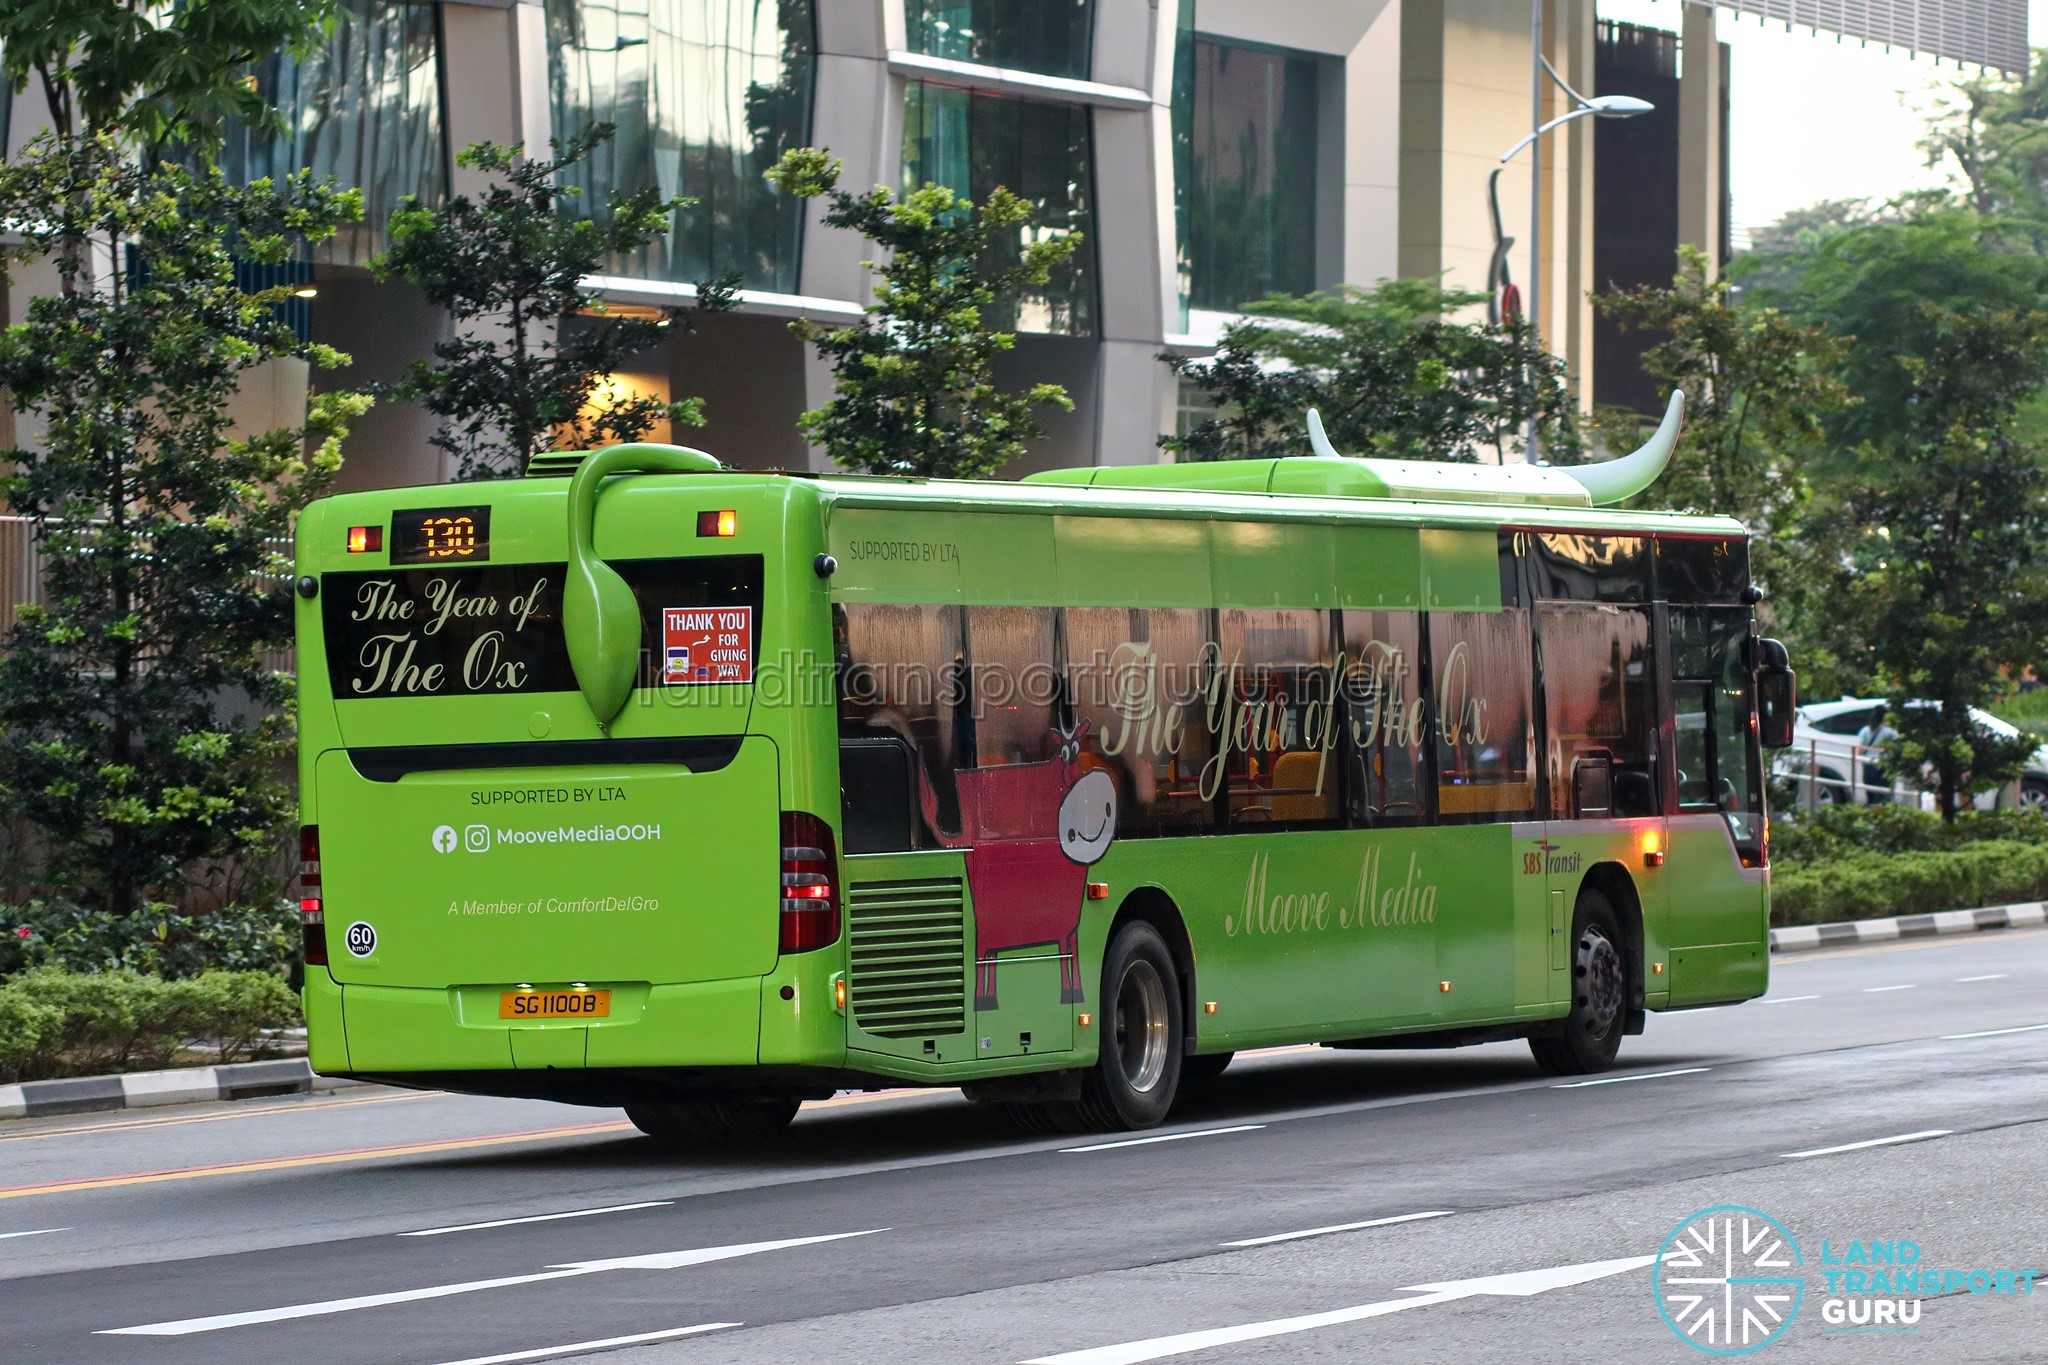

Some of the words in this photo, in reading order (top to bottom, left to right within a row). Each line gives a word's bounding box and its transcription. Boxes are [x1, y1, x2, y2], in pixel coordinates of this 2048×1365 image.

[421, 517, 474, 556] 130
[850, 541, 920, 561] SUPPORTED
[922, 543, 937, 561] BY
[940, 544, 960, 562] LTA
[351, 579, 416, 621] The
[423, 578, 499, 635] Year
[509, 577, 548, 632] of
[668, 613, 714, 631] THANK
[717, 612, 745, 630] YOU
[718, 633, 739, 646] FOR
[352, 631, 446, 693] The
[463, 630, 528, 690] Ox
[710, 648, 747, 661] GIVING
[717, 664, 740, 676] WAY
[1101, 641, 1186, 757] The
[1195, 641, 1293, 802] Year
[1304, 651, 1347, 797] of
[1352, 639, 1427, 749] The
[1440, 641, 1489, 747] Ox
[470, 789, 569, 805] SUPPORTED
[573, 788, 594, 802] BY
[598, 787, 627, 801] LTA
[497, 824, 661, 844] MooveMediaOOH
[1523, 852, 1542, 875] SBS
[1543, 847, 1583, 875] Transit
[1226, 851, 1330, 937] Moove
[1339, 845, 1438, 929] Media
[447, 900, 459, 916] A
[463, 899, 522, 915] Member
[527, 898, 543, 914] of
[546, 896, 659, 913] ComfortDelGro
[350, 927, 372, 945] 60
[351, 944, 371, 952] km/h
[514, 995, 596, 1014] SG1100B
